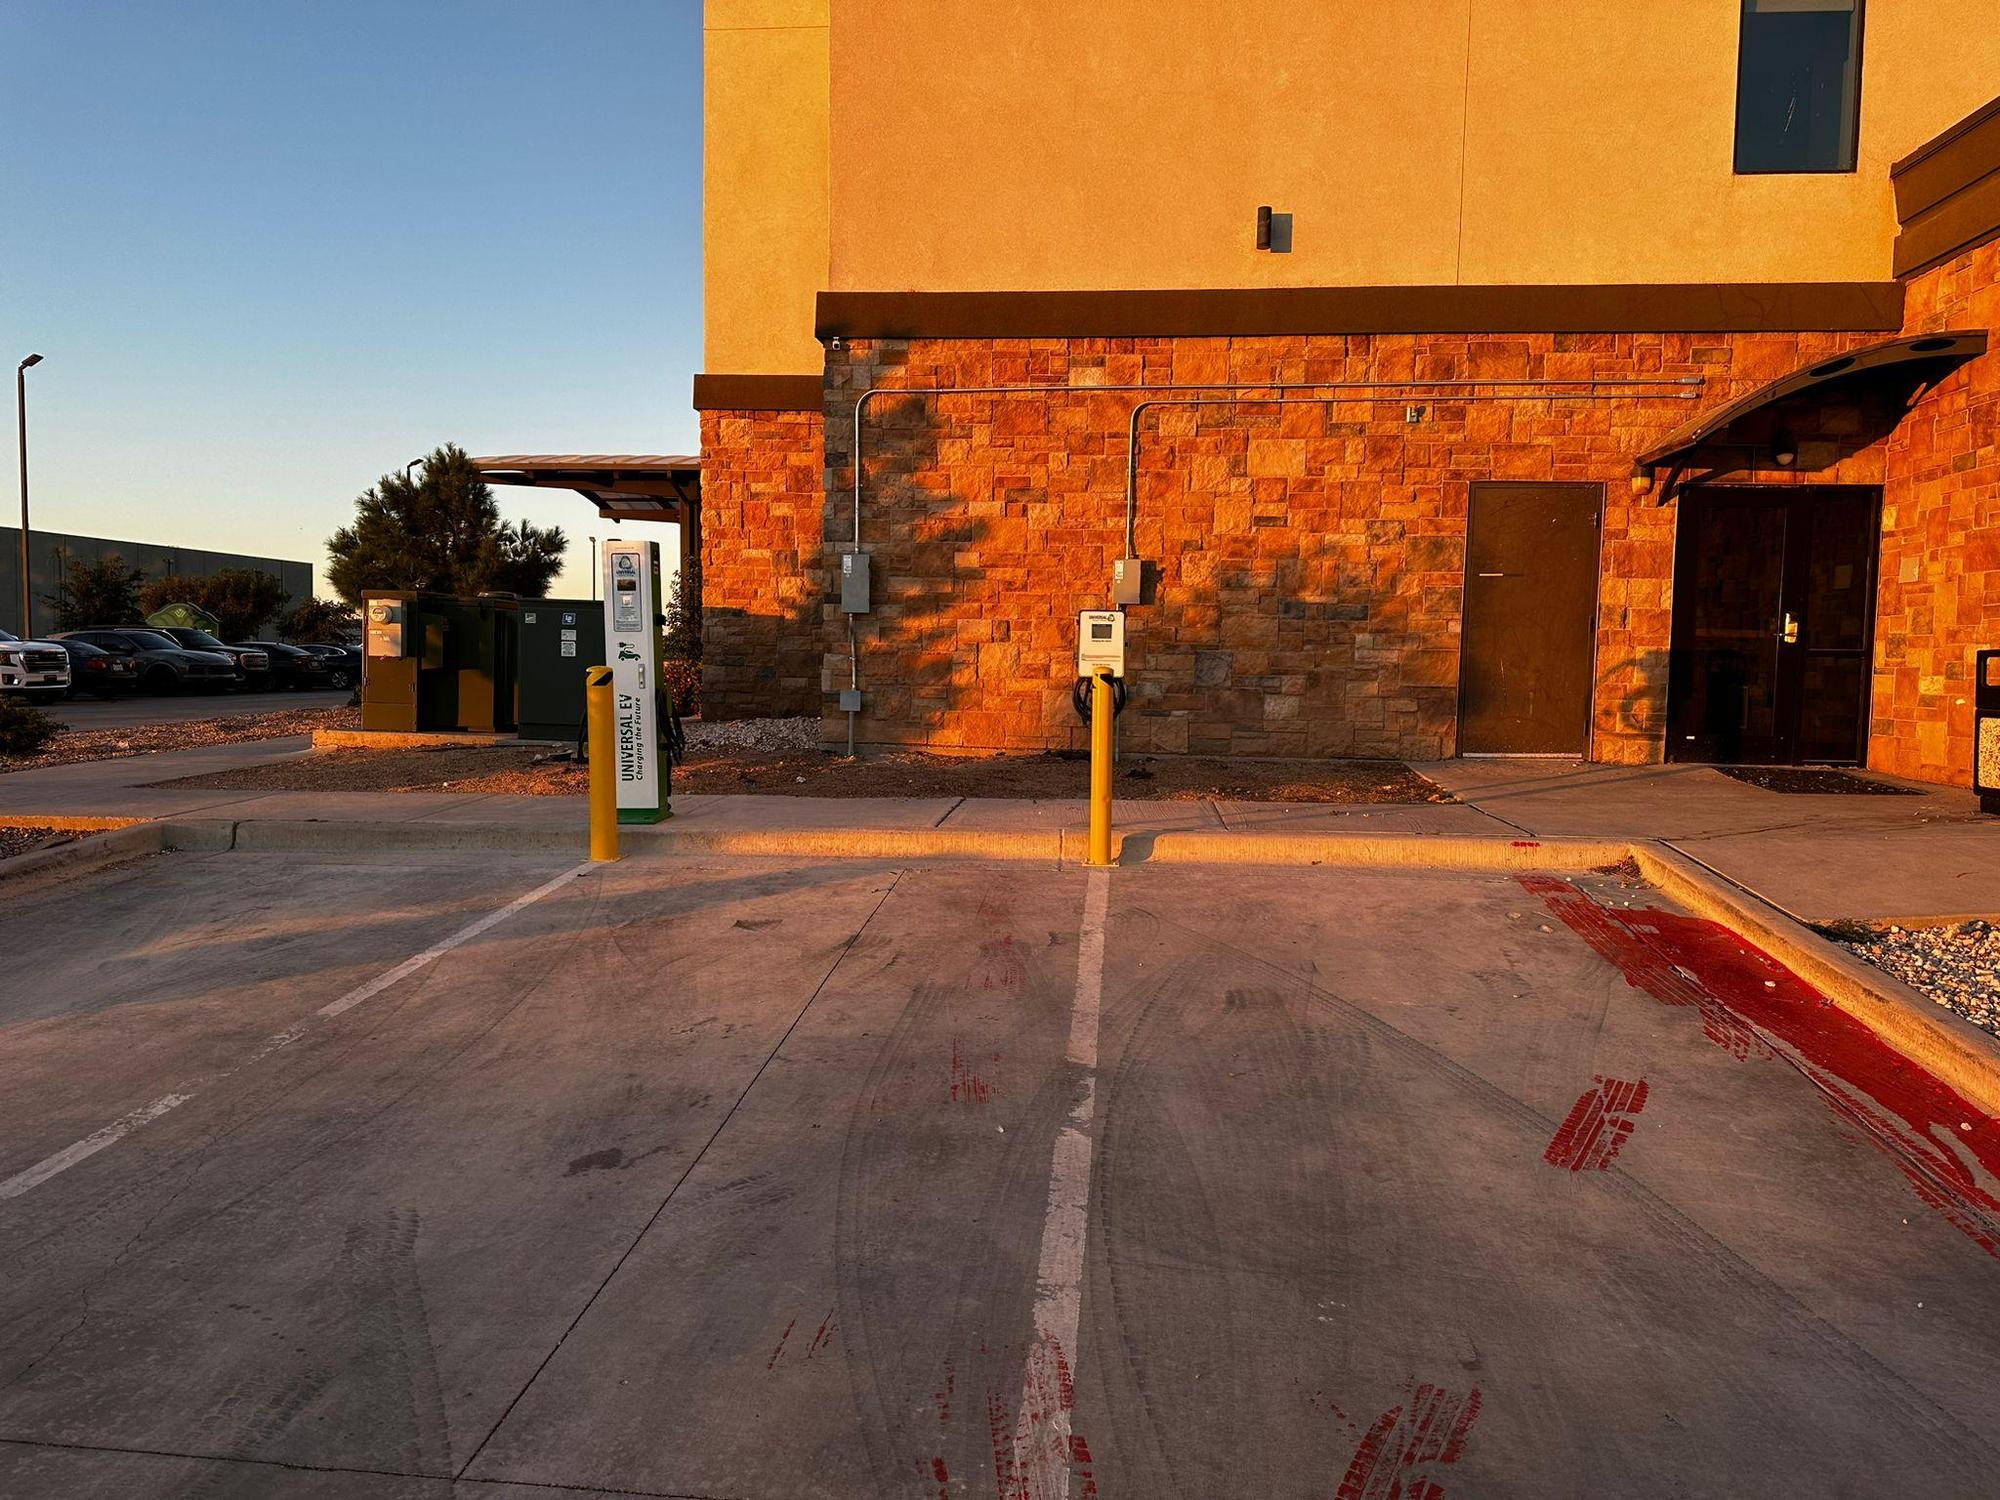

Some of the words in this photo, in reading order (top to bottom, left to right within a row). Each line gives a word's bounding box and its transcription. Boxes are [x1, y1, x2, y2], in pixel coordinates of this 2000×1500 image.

[619, 694, 632, 709] EV
[621, 714, 634, 781] UNIVERSAL
[636, 743, 644, 780] Charging
